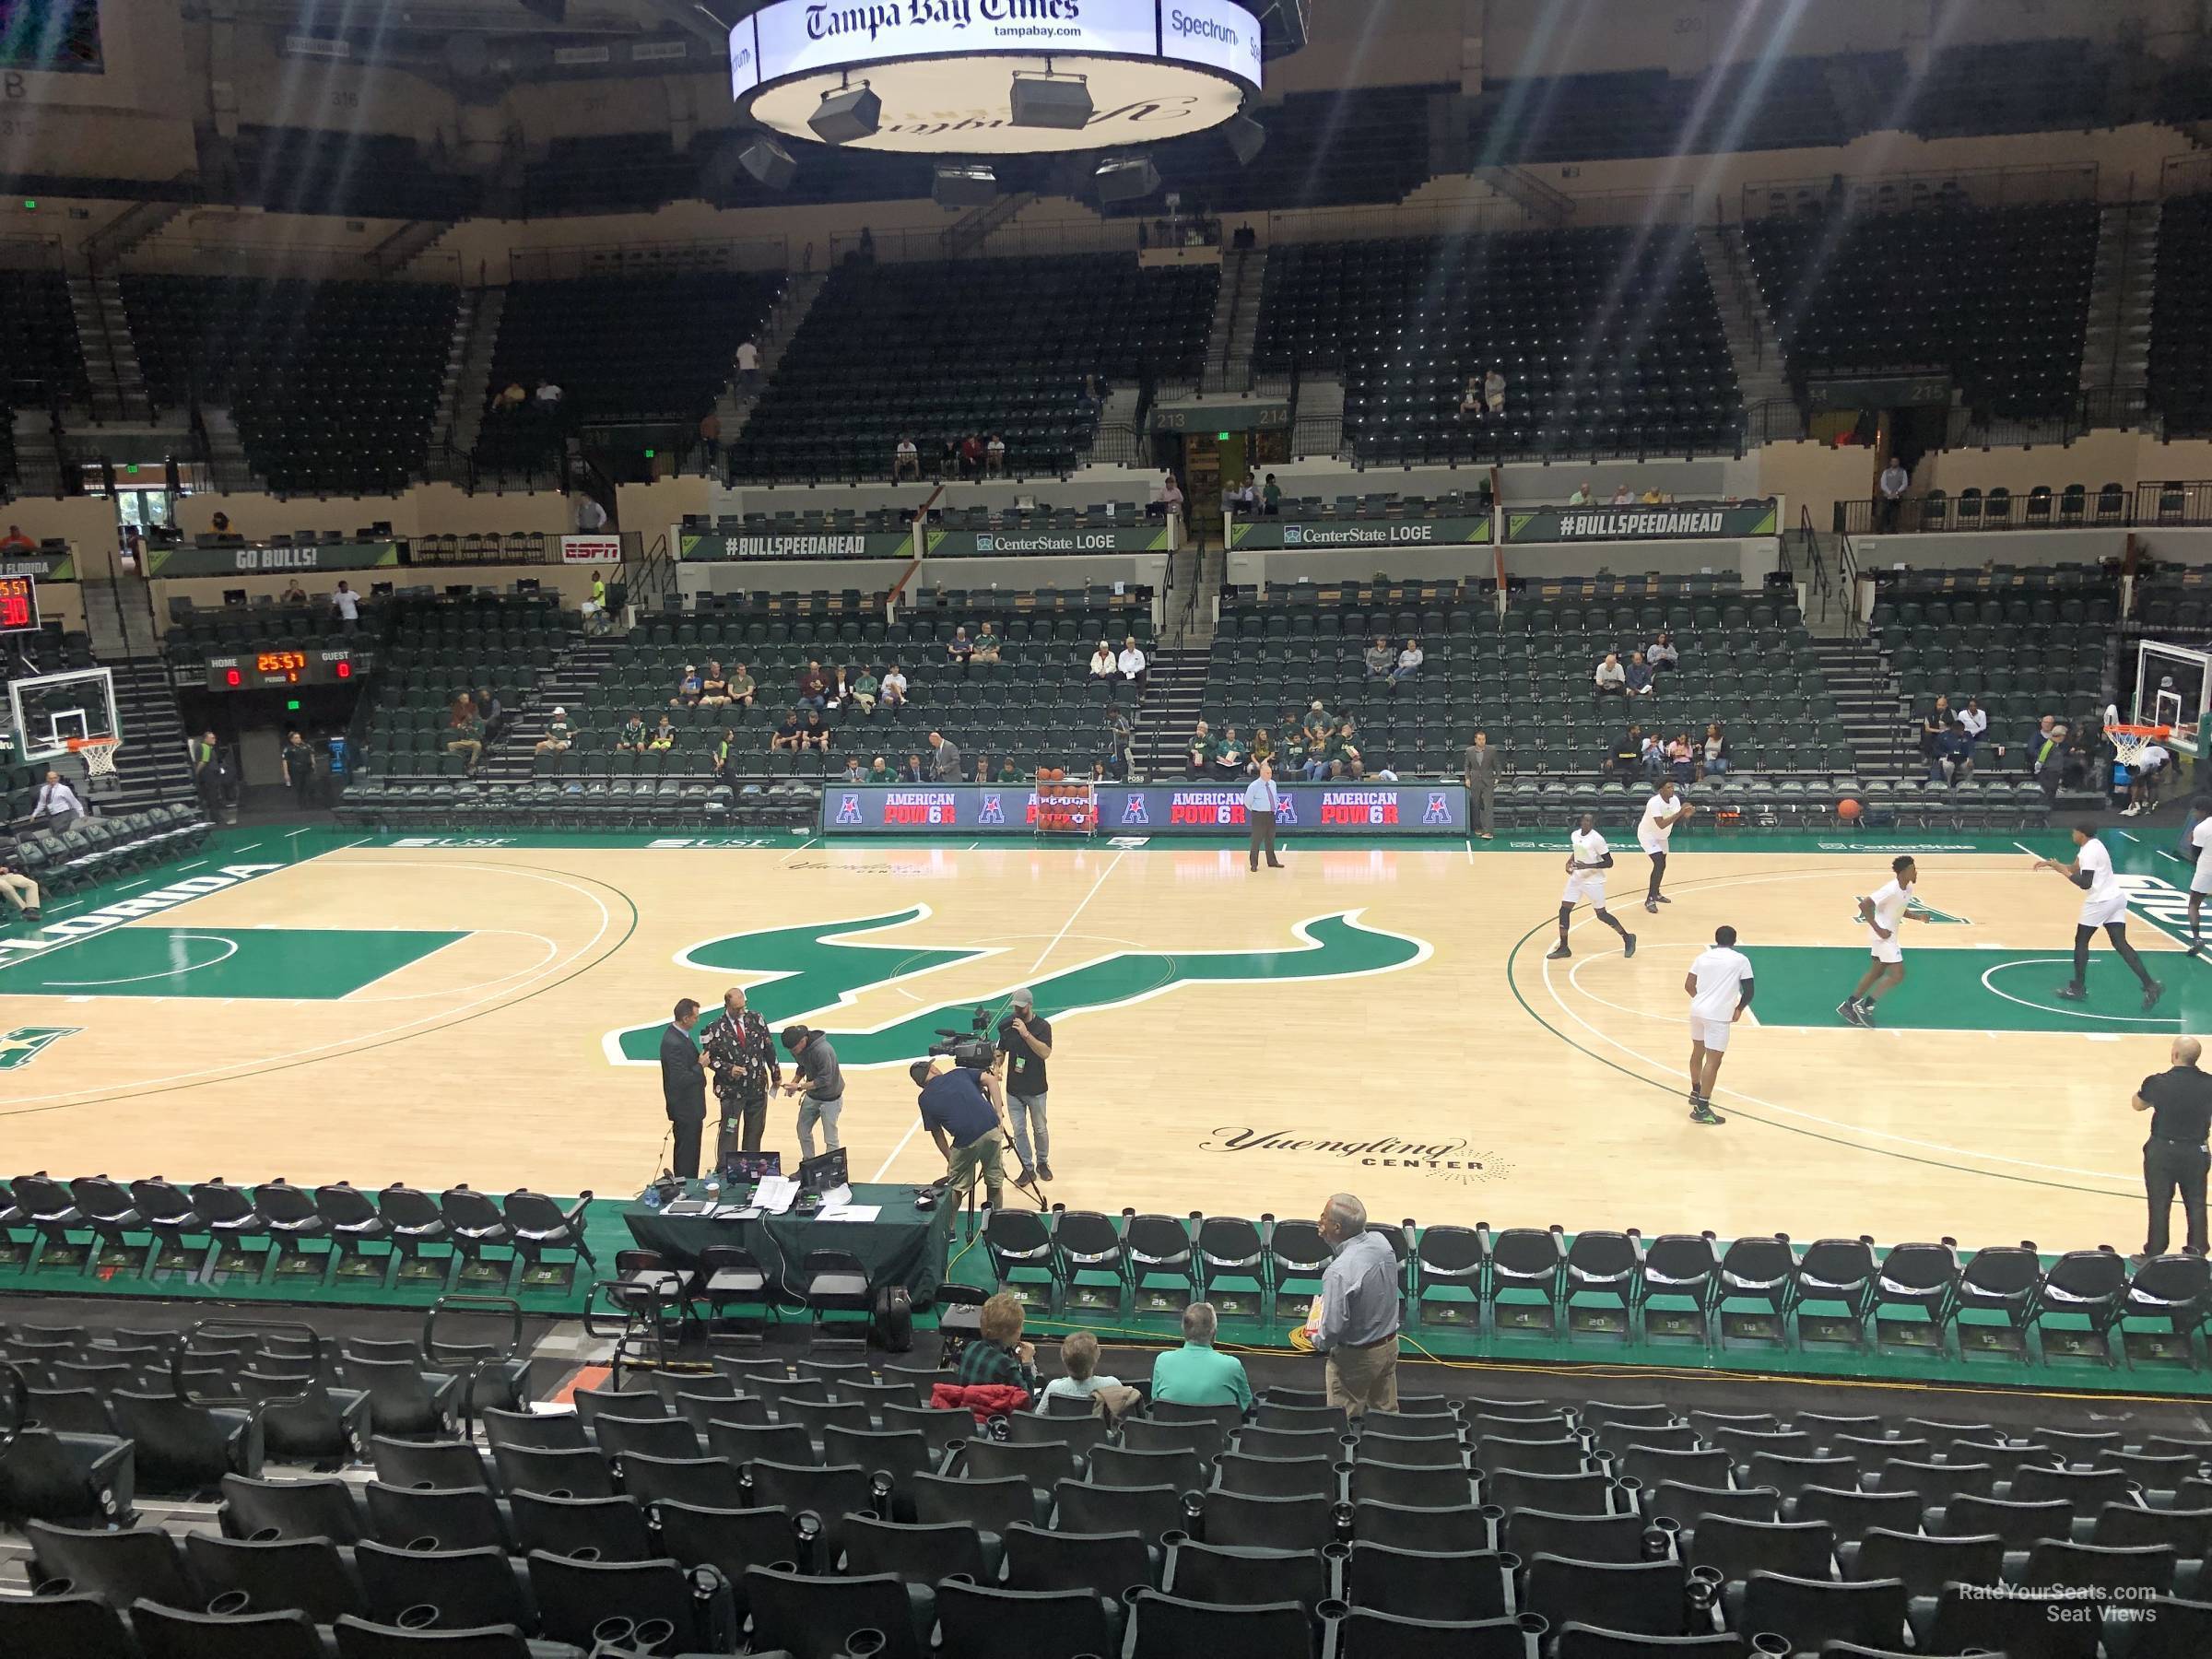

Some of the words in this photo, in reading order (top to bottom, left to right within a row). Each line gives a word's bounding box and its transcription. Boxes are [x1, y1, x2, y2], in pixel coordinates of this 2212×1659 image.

[806, 2, 900, 42] Tampa
[1171, 9, 1238, 46] Spectrum
[994, 25, 1082, 38] tampabay.com
[1158, 413, 1186, 428] 213
[1260, 409, 1288, 424] 214
[1559, 512, 1723, 536] #BULLSPEEDAHEAD
[1302, 528, 1386, 543] CenterState
[1390, 525, 1431, 540] LOGE
[565, 543, 618, 558] ESPN
[725, 535, 865, 556] #BULLSPEEDAHEAD
[994, 536, 1073, 552] CenterState
[1077, 535, 1115, 549] LOGE
[236, 550, 257, 569] GO
[263, 548, 317, 568] BULLS!
[6, 562, 49, 574] FLORIDA
[211, 658, 238, 668] HOME
[258, 653, 305, 672] 25:57
[322, 651, 349, 661] GUEST
[228, 670, 241, 685] 0
[338, 663, 349, 677] 0
[886, 793, 955, 806] AMERICAN
[1172, 793, 1244, 806] AMERICAN
[1322, 793, 1397, 806] AMERICAN
[884, 805, 957, 824] POW6R
[1171, 805, 1246, 824] POW6R
[1322, 805, 1399, 824] POW6R
[1199, 1126, 1467, 1160] Yuengling
[1361, 1158, 1483, 1171] CENTER
[1152, 1298, 1167, 1306] 26
[1588, 1318, 1605, 1326] 20
